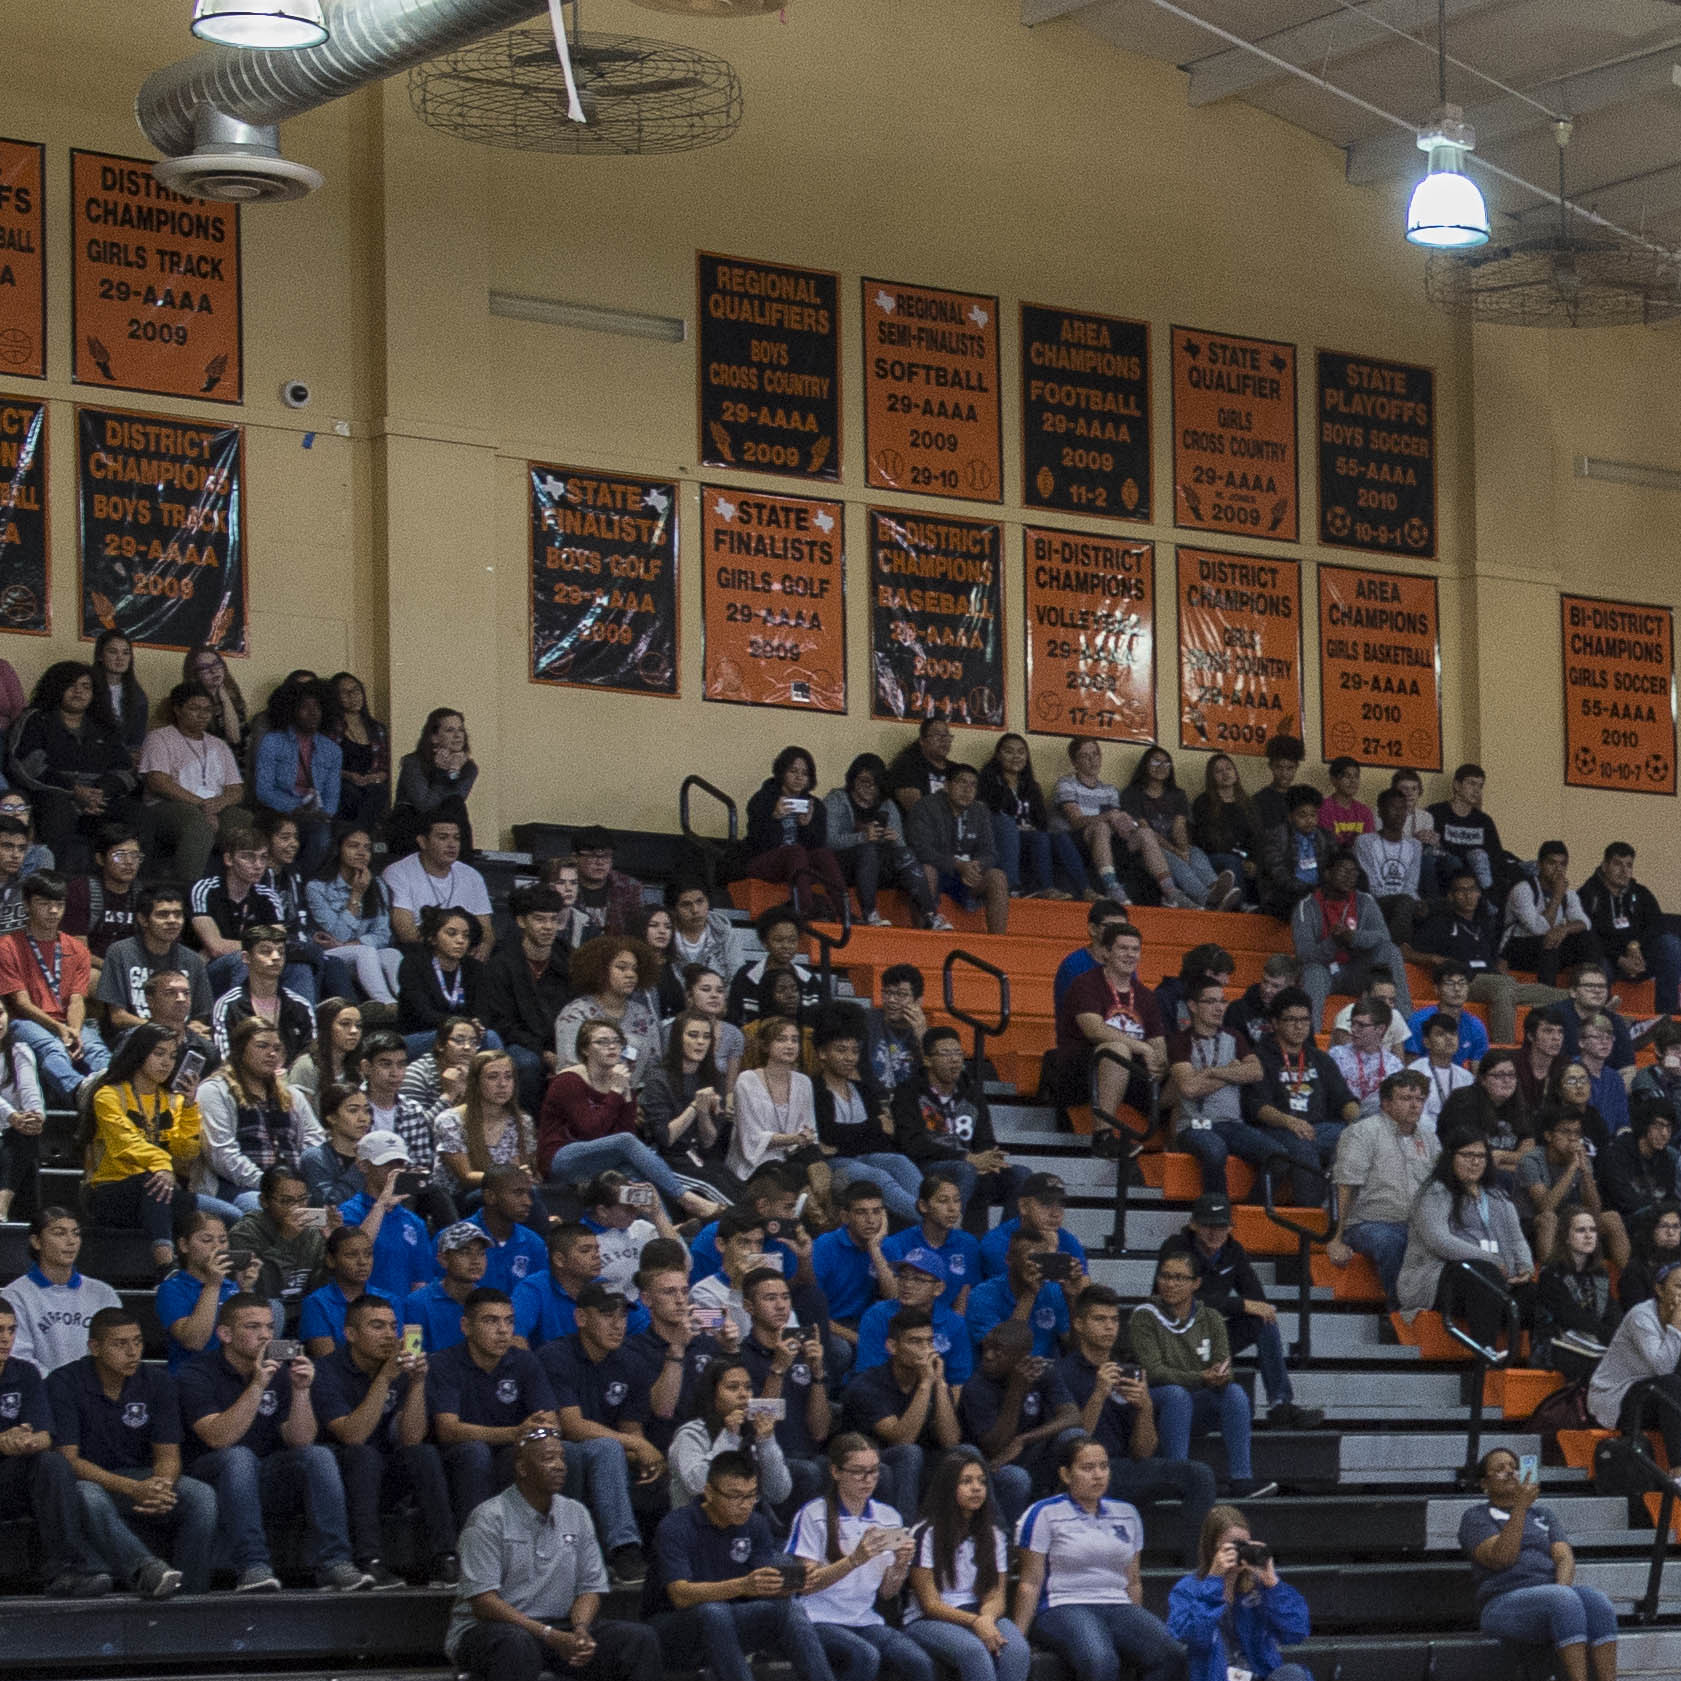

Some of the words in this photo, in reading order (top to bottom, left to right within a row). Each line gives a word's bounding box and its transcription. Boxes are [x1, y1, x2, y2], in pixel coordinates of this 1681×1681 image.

[85, 197, 225, 243] CHAMPIONS
[87, 239, 147, 270] GIRLS
[156, 249, 224, 281] TRACK
[99, 277, 213, 314] 29-AAAA
[717, 266, 821, 304] REGIONAL
[709, 295, 828, 334] QUALIFIERS
[896, 294, 964, 325] REGIONAL
[128, 319, 188, 346] 2009
[878, 321, 985, 359] SEMI-FINALISTS
[1060, 320, 1110, 348] AREA
[750, 340, 788, 367] BOYS
[1030, 342, 1141, 380] CHAMPIONS
[709, 362, 758, 391] CROSS
[763, 369, 829, 399] COUNTRY
[874, 358, 988, 392] SOFTBALL
[887, 394, 978, 421] 29-AAAA
[1030, 381, 1141, 417] FOOTBALL
[722, 401, 818, 433] 29-AAAA
[1042, 412, 1130, 442] 29-AAAA
[743, 442, 799, 467] 2009
[910, 429, 958, 452] 2009
[1062, 448, 1114, 471] 2009
[911, 467, 958, 489] 29-10
[1069, 484, 1107, 506] 11-2
[1356, 580, 1401, 603] AREA
[1329, 604, 1428, 635] CHAMPIONS
[1570, 606, 1663, 636] BI-DISTRICT
[1327, 640, 1358, 661] GIRLS
[1363, 643, 1432, 668] BASKETBALL
[1570, 634, 1663, 664] CHAMPIONS
[1340, 672, 1420, 696] 29-AAAA
[1569, 667, 1607, 689] GIRLS
[1614, 672, 1667, 695] SOCCER
[1362, 703, 1401, 723] 2010
[1582, 700, 1656, 722] 55-AAAA
[1363, 737, 1402, 757] 27-12
[1602, 729, 1638, 747] 2010
[1600, 761, 1640, 780] 10-10-7
[55, 1311, 94, 1329] FORC
